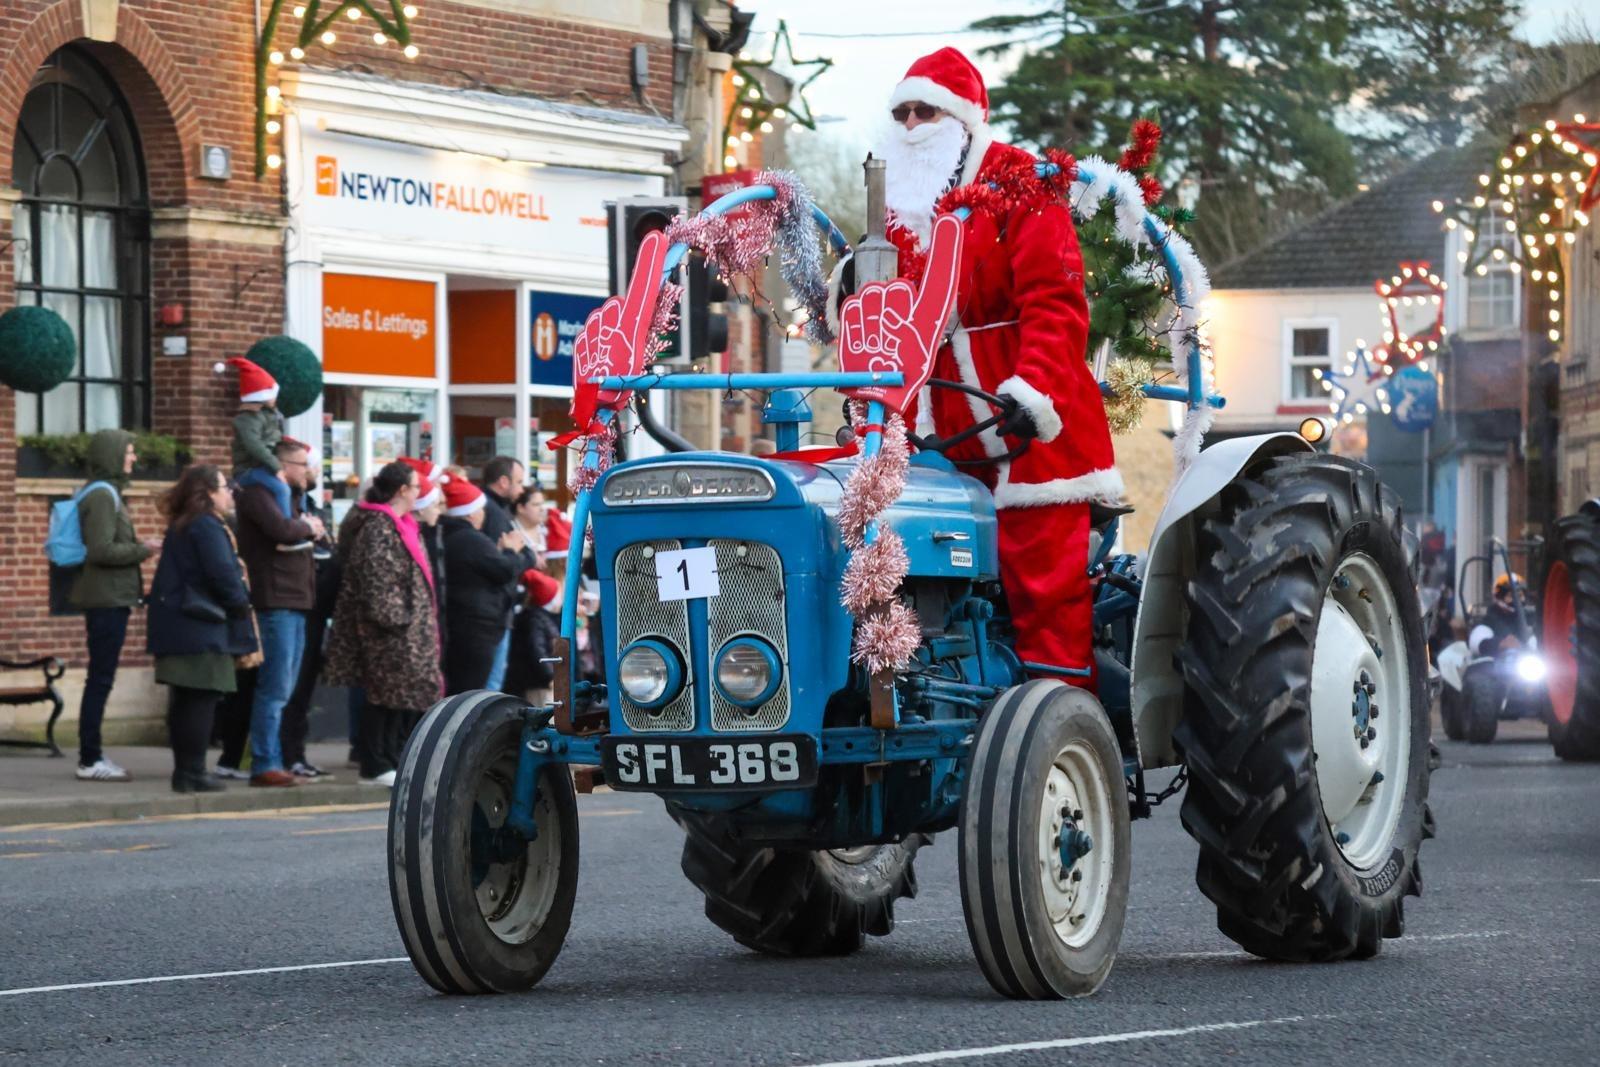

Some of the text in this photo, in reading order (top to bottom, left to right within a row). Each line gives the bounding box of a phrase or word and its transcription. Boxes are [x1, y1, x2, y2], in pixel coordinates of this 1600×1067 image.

[324, 306, 428, 340] Sales & Lettings
[692, 477, 760, 495] DEXTA
[677, 559, 690, 591] 1
[616, 742, 800, 784] SFL 368
